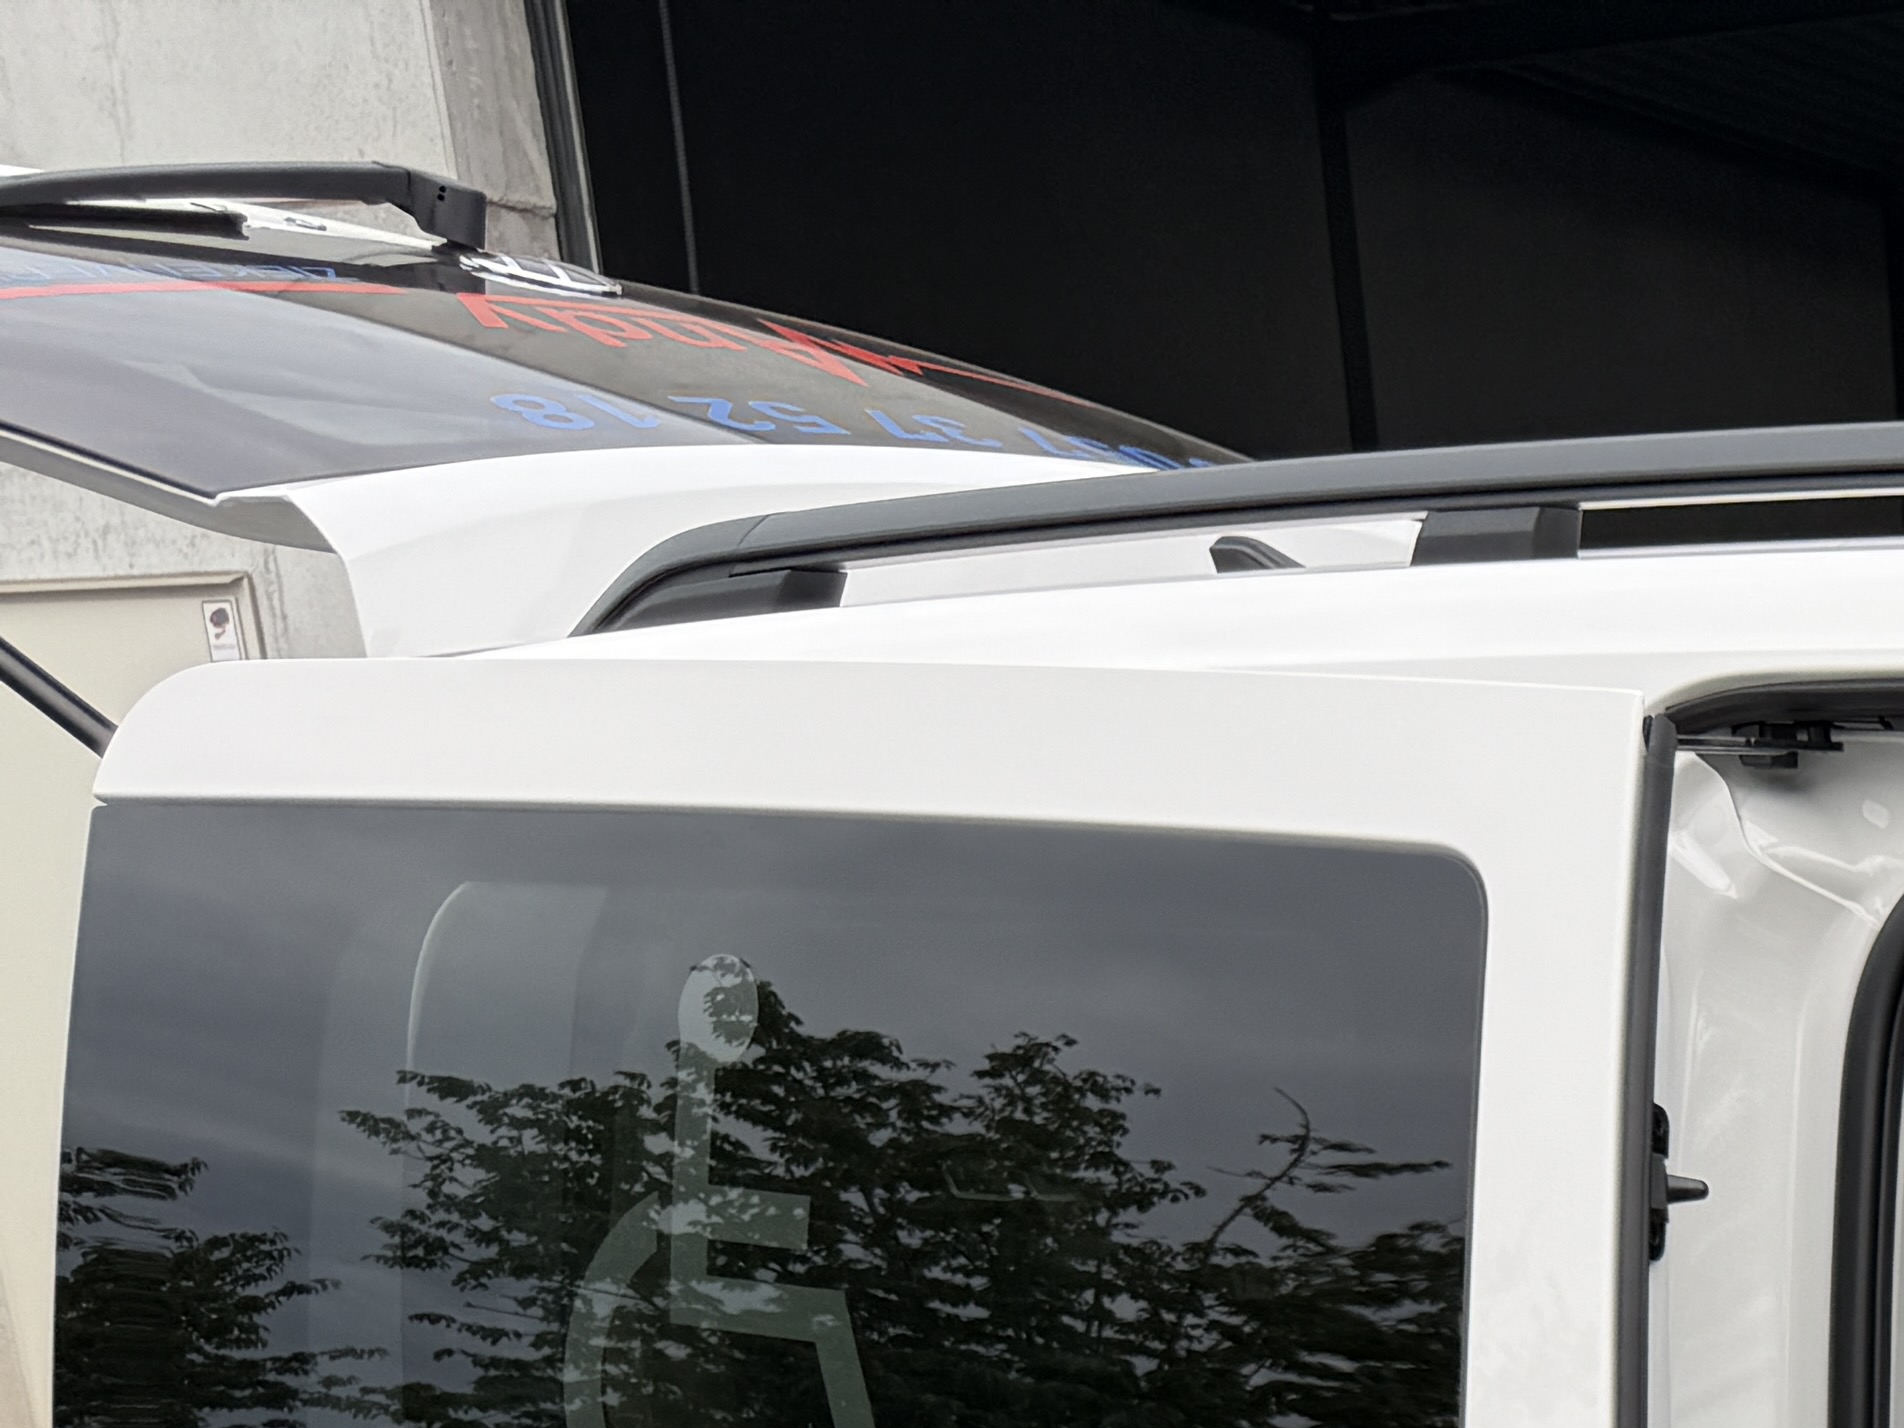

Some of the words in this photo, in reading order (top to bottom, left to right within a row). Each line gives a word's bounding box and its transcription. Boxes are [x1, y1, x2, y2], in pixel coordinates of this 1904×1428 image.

[457, 293, 870, 388] Andy
[489, 391, 661, 431] 18
[667, 395, 852, 435] 52
[865, 409, 1003, 449] 37
